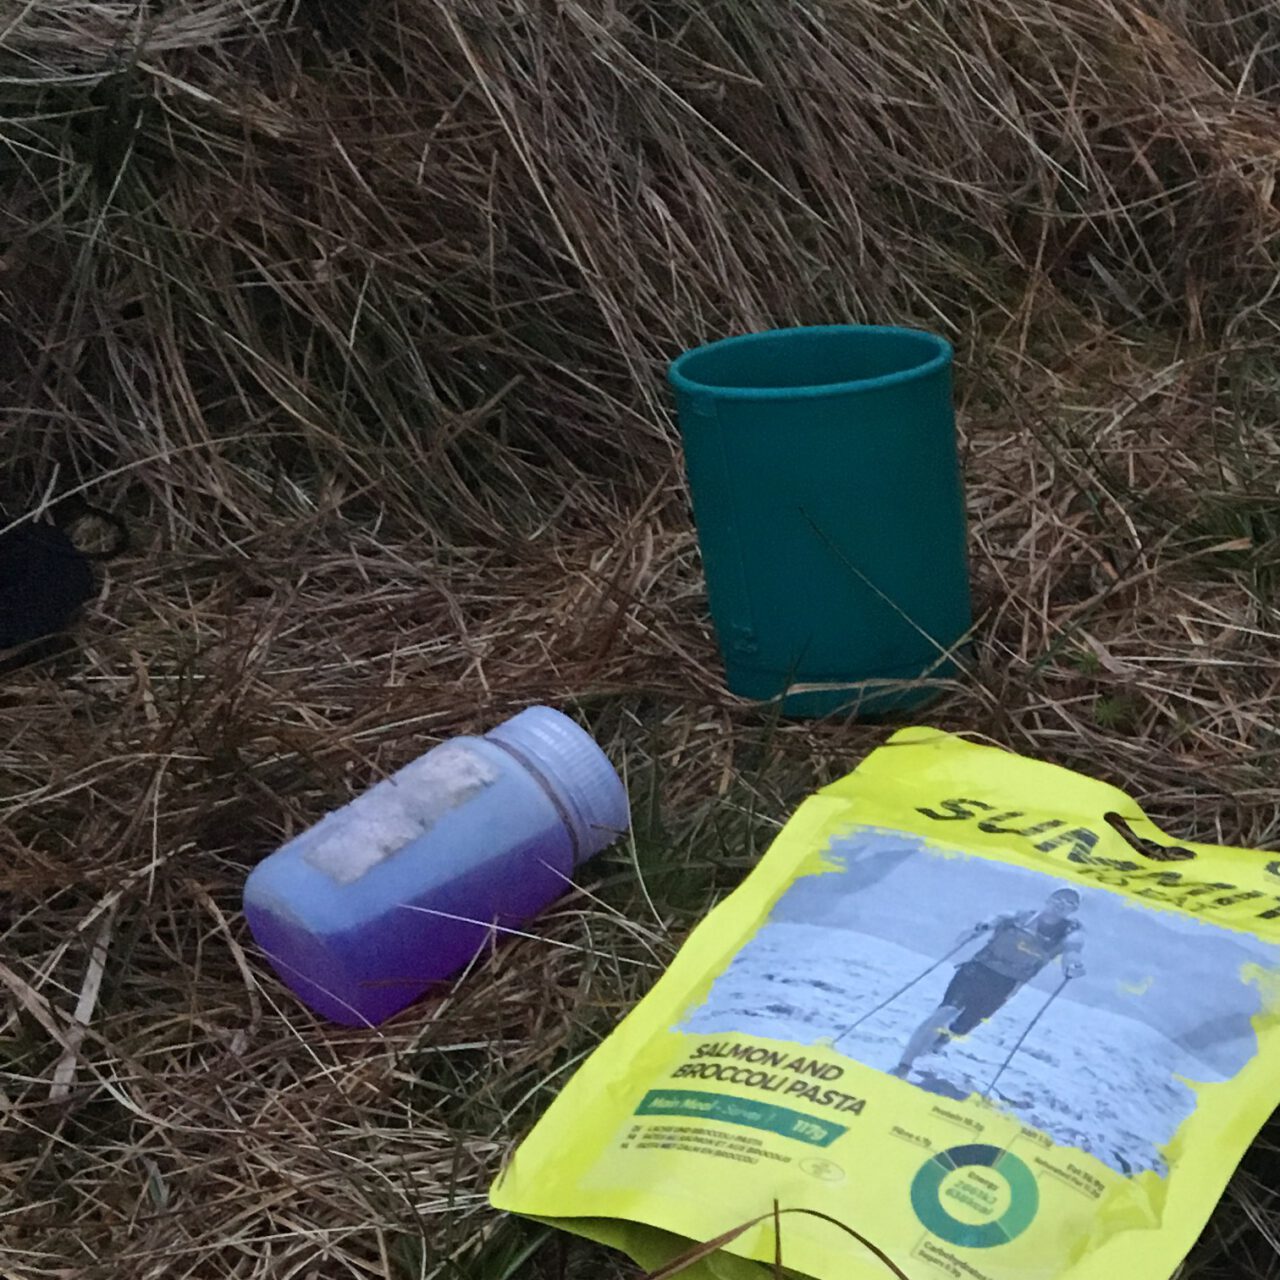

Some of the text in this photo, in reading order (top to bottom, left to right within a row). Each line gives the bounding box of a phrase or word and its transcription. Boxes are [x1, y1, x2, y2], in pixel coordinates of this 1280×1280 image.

[689, 1042, 844, 1081] SALMON AND
[670, 1063, 866, 1116] BROCCOLI PASTA
